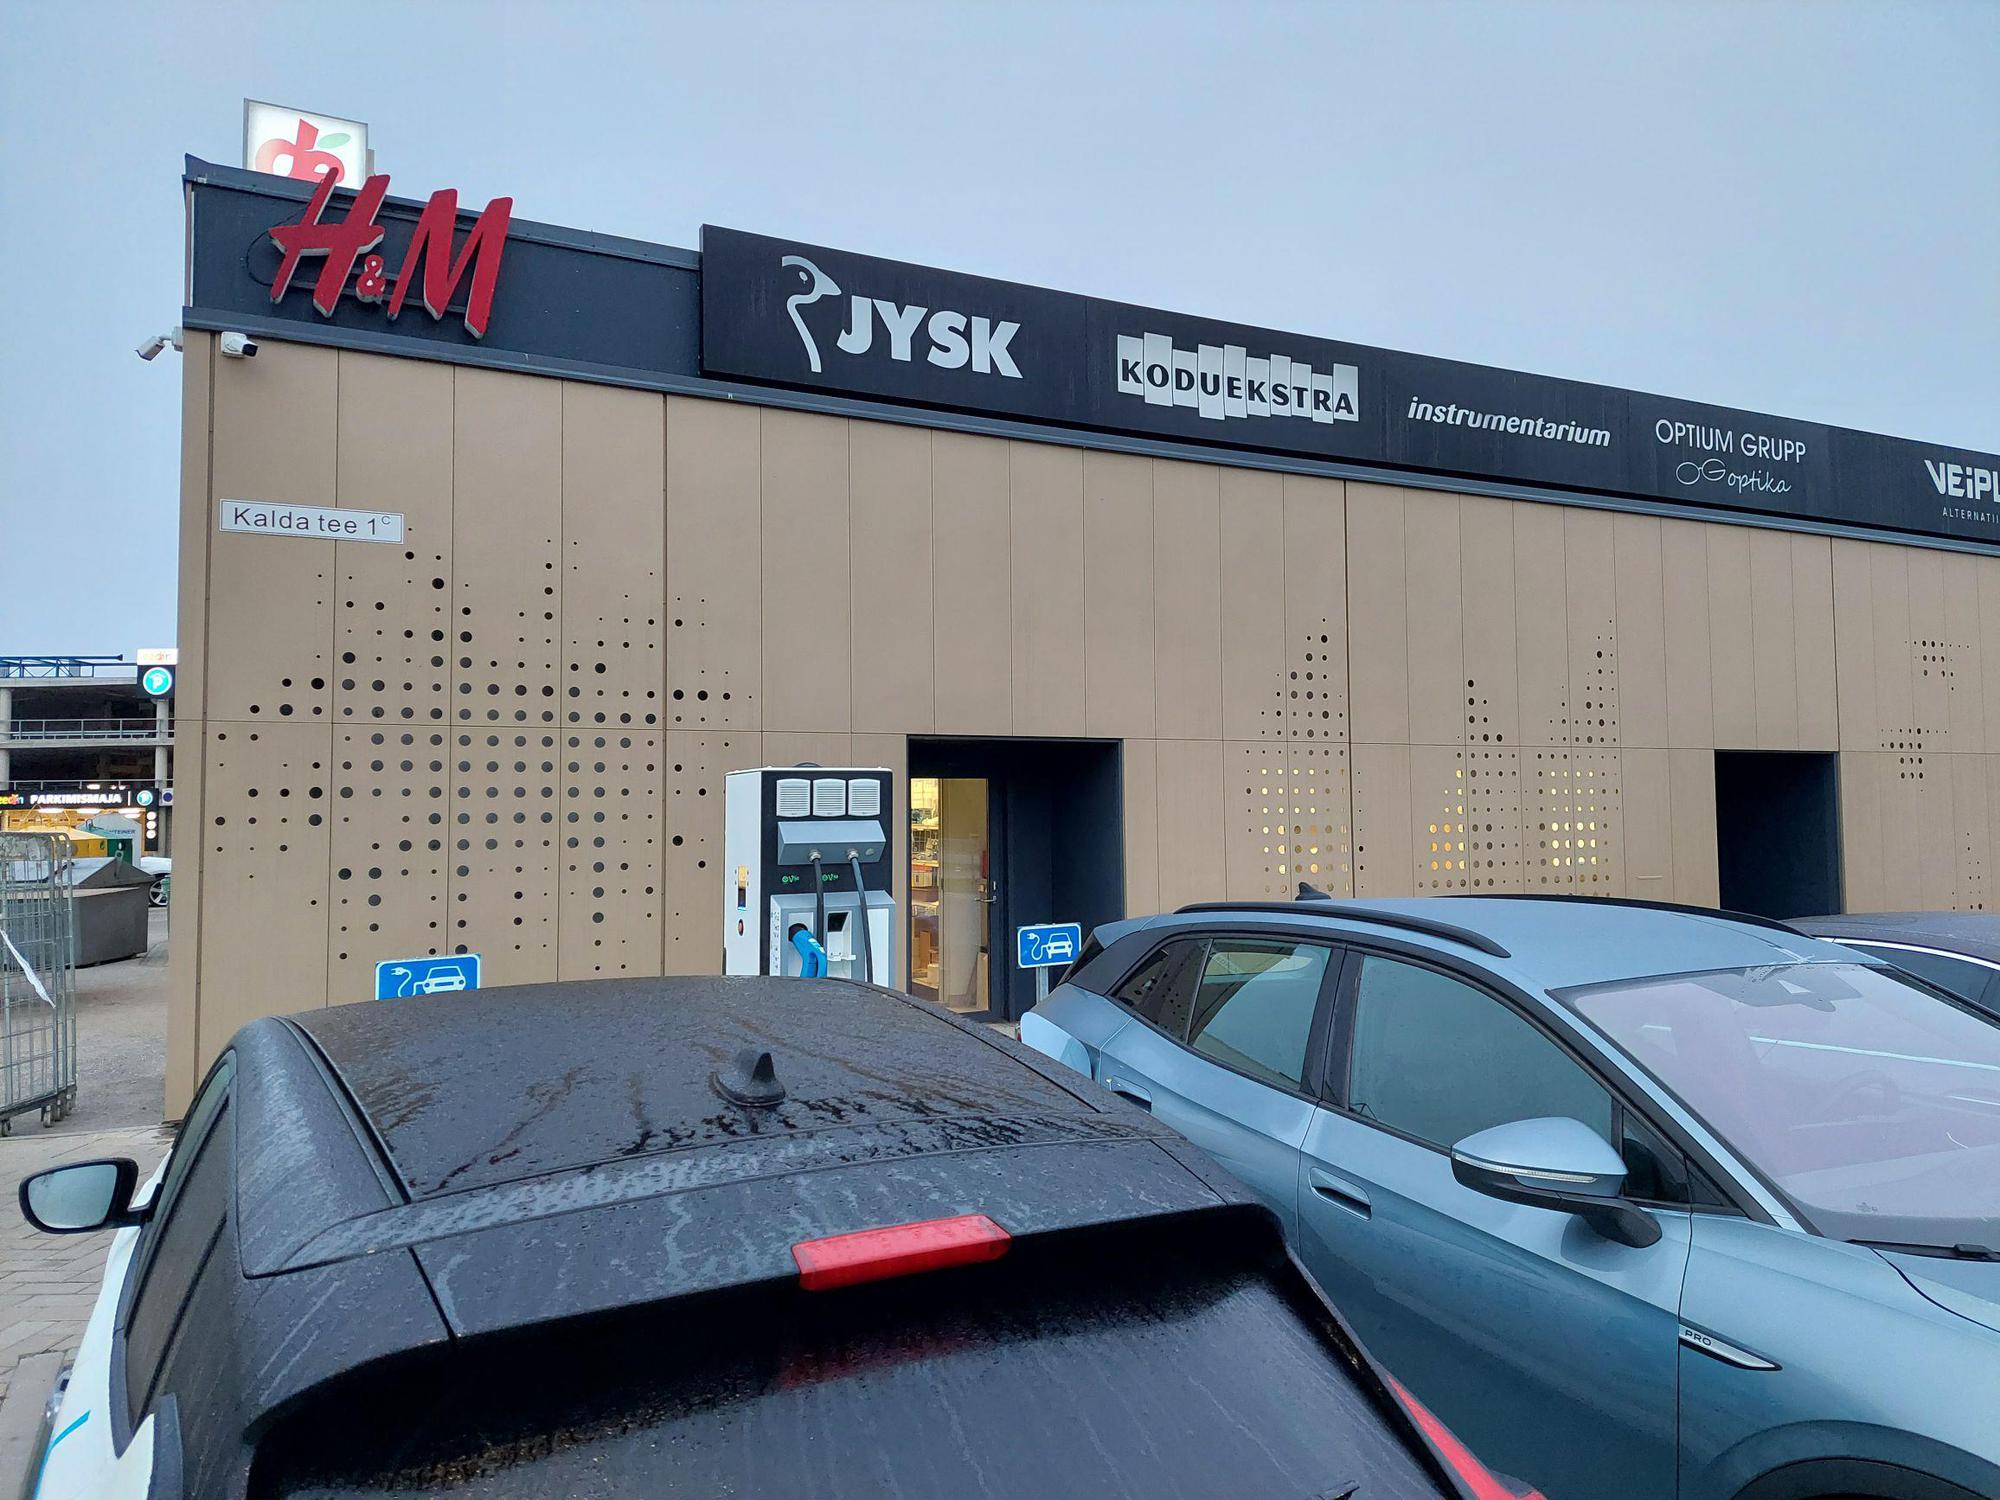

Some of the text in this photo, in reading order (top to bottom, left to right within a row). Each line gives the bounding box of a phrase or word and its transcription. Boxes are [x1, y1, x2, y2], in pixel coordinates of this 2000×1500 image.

[268, 167, 514, 339] H&M
[836, 295, 1023, 379] JYSK
[1120, 357, 1355, 416] KODUEKSTRA
[1407, 396, 1611, 447] instrumentarium
[1655, 419, 1806, 463] OPTIUM GRUPP
[1727, 470, 1792, 494] optika
[234, 507, 309, 530] Kalda
[318, 514, 357, 534] tee
[30, 794, 122, 806] PARKIMISMAJA
[1684, 1329, 1712, 1347] PRO
